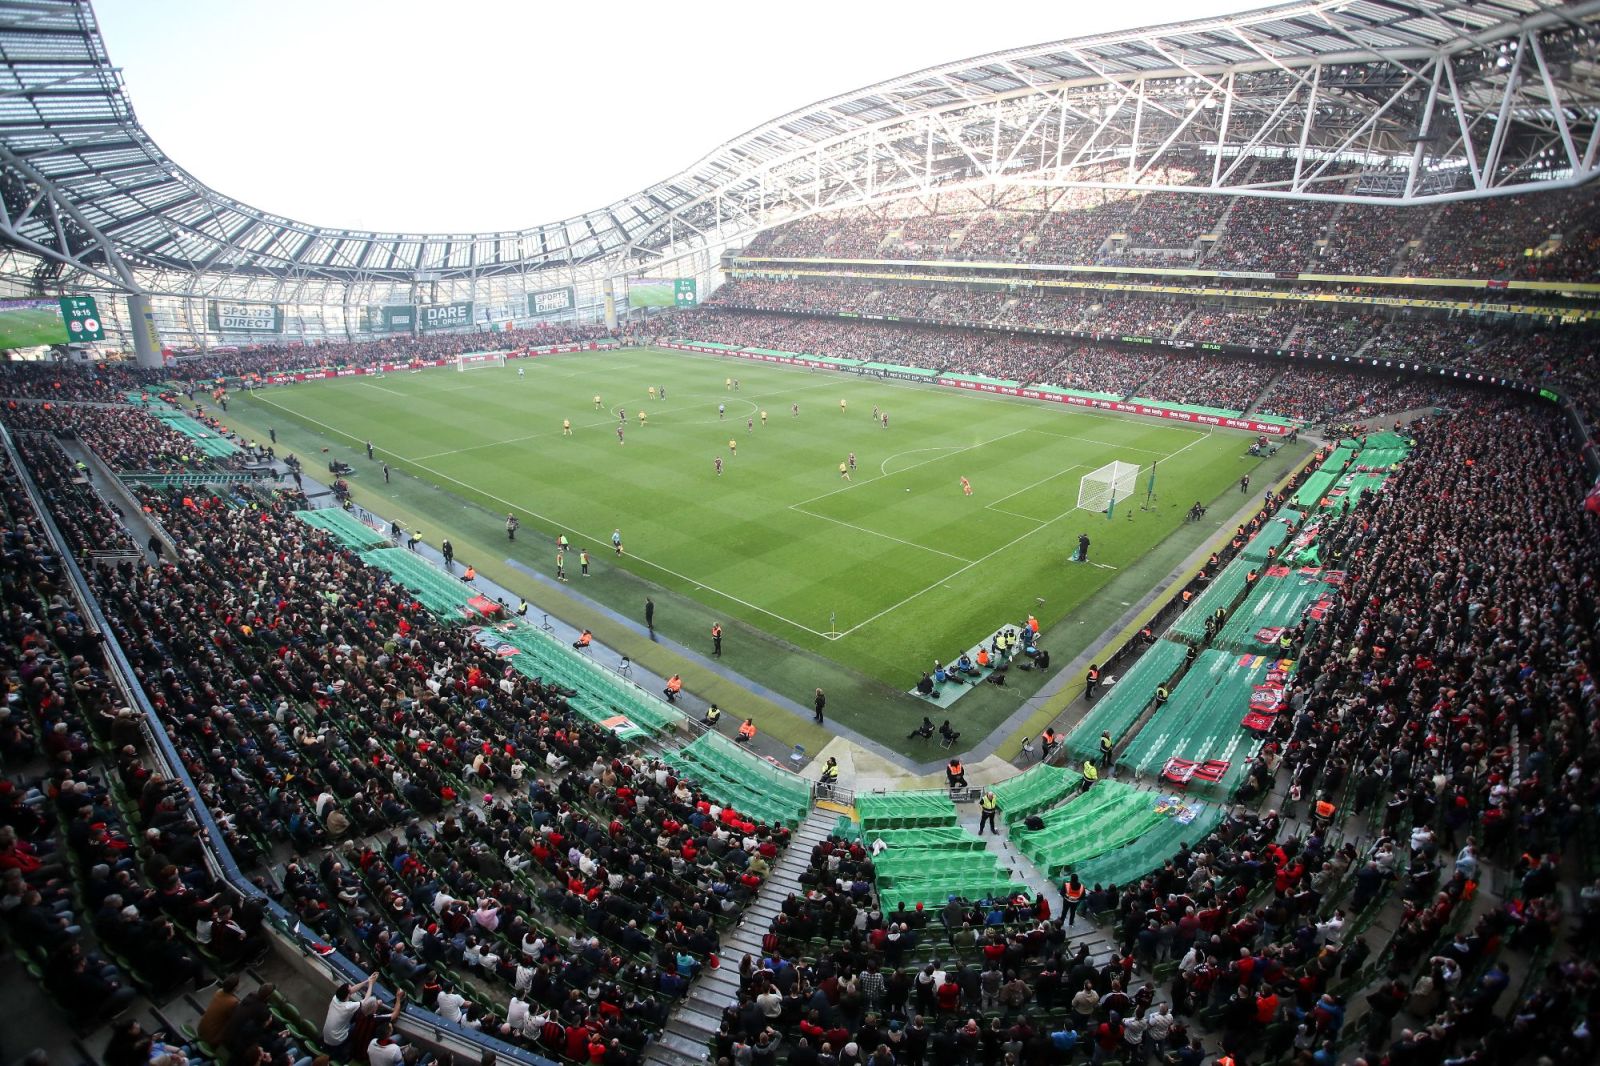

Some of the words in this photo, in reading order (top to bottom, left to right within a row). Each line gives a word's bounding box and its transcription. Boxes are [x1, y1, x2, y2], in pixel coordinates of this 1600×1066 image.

[223, 306, 272, 317] SPORTS
[427, 305, 467, 320] DARE
[223, 319, 272, 328] DIRECT
[442, 317, 467, 325] DREAM
[1152, 408, 1163, 416] kelly
[1179, 412, 1190, 420] kelly
[1207, 416, 1219, 424] kelly
[1237, 420, 1249, 428] kelly
[1267, 424, 1280, 432] kelly
